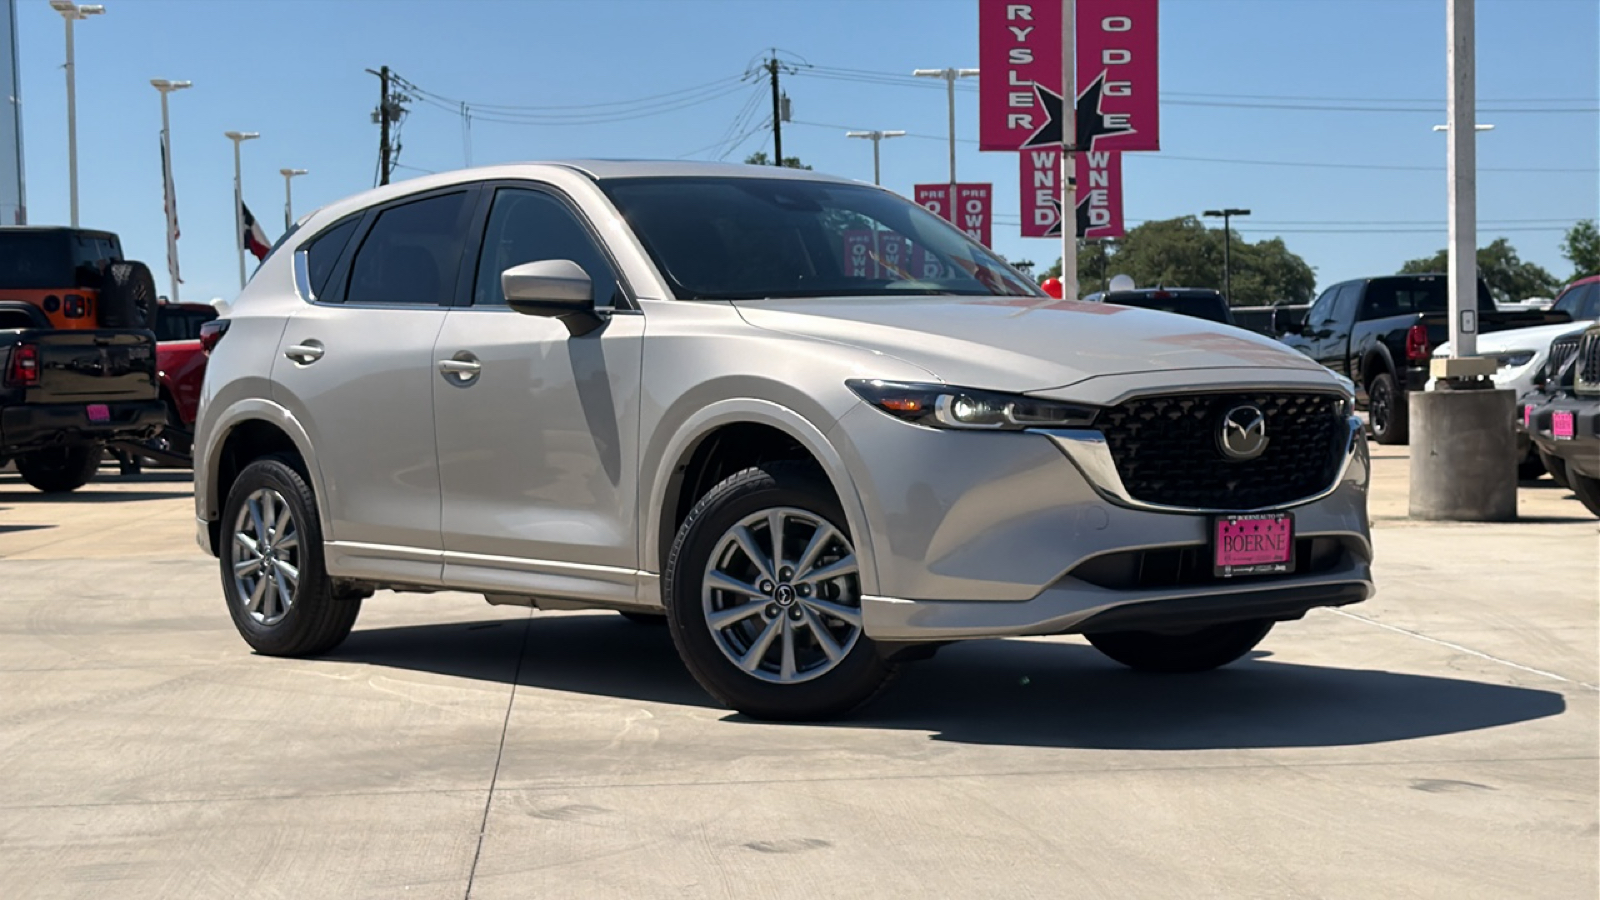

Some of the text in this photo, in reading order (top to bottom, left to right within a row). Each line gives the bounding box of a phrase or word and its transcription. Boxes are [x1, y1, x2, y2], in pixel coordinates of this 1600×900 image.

[1101, 16, 1132, 129] ODGE
[920, 190, 945, 198] PRE
[962, 189, 986, 197] PRE
[1031, 152, 1055, 225] WNED
[1087, 152, 1111, 225] WNED
[1224, 534, 1286, 552] BOERNE
